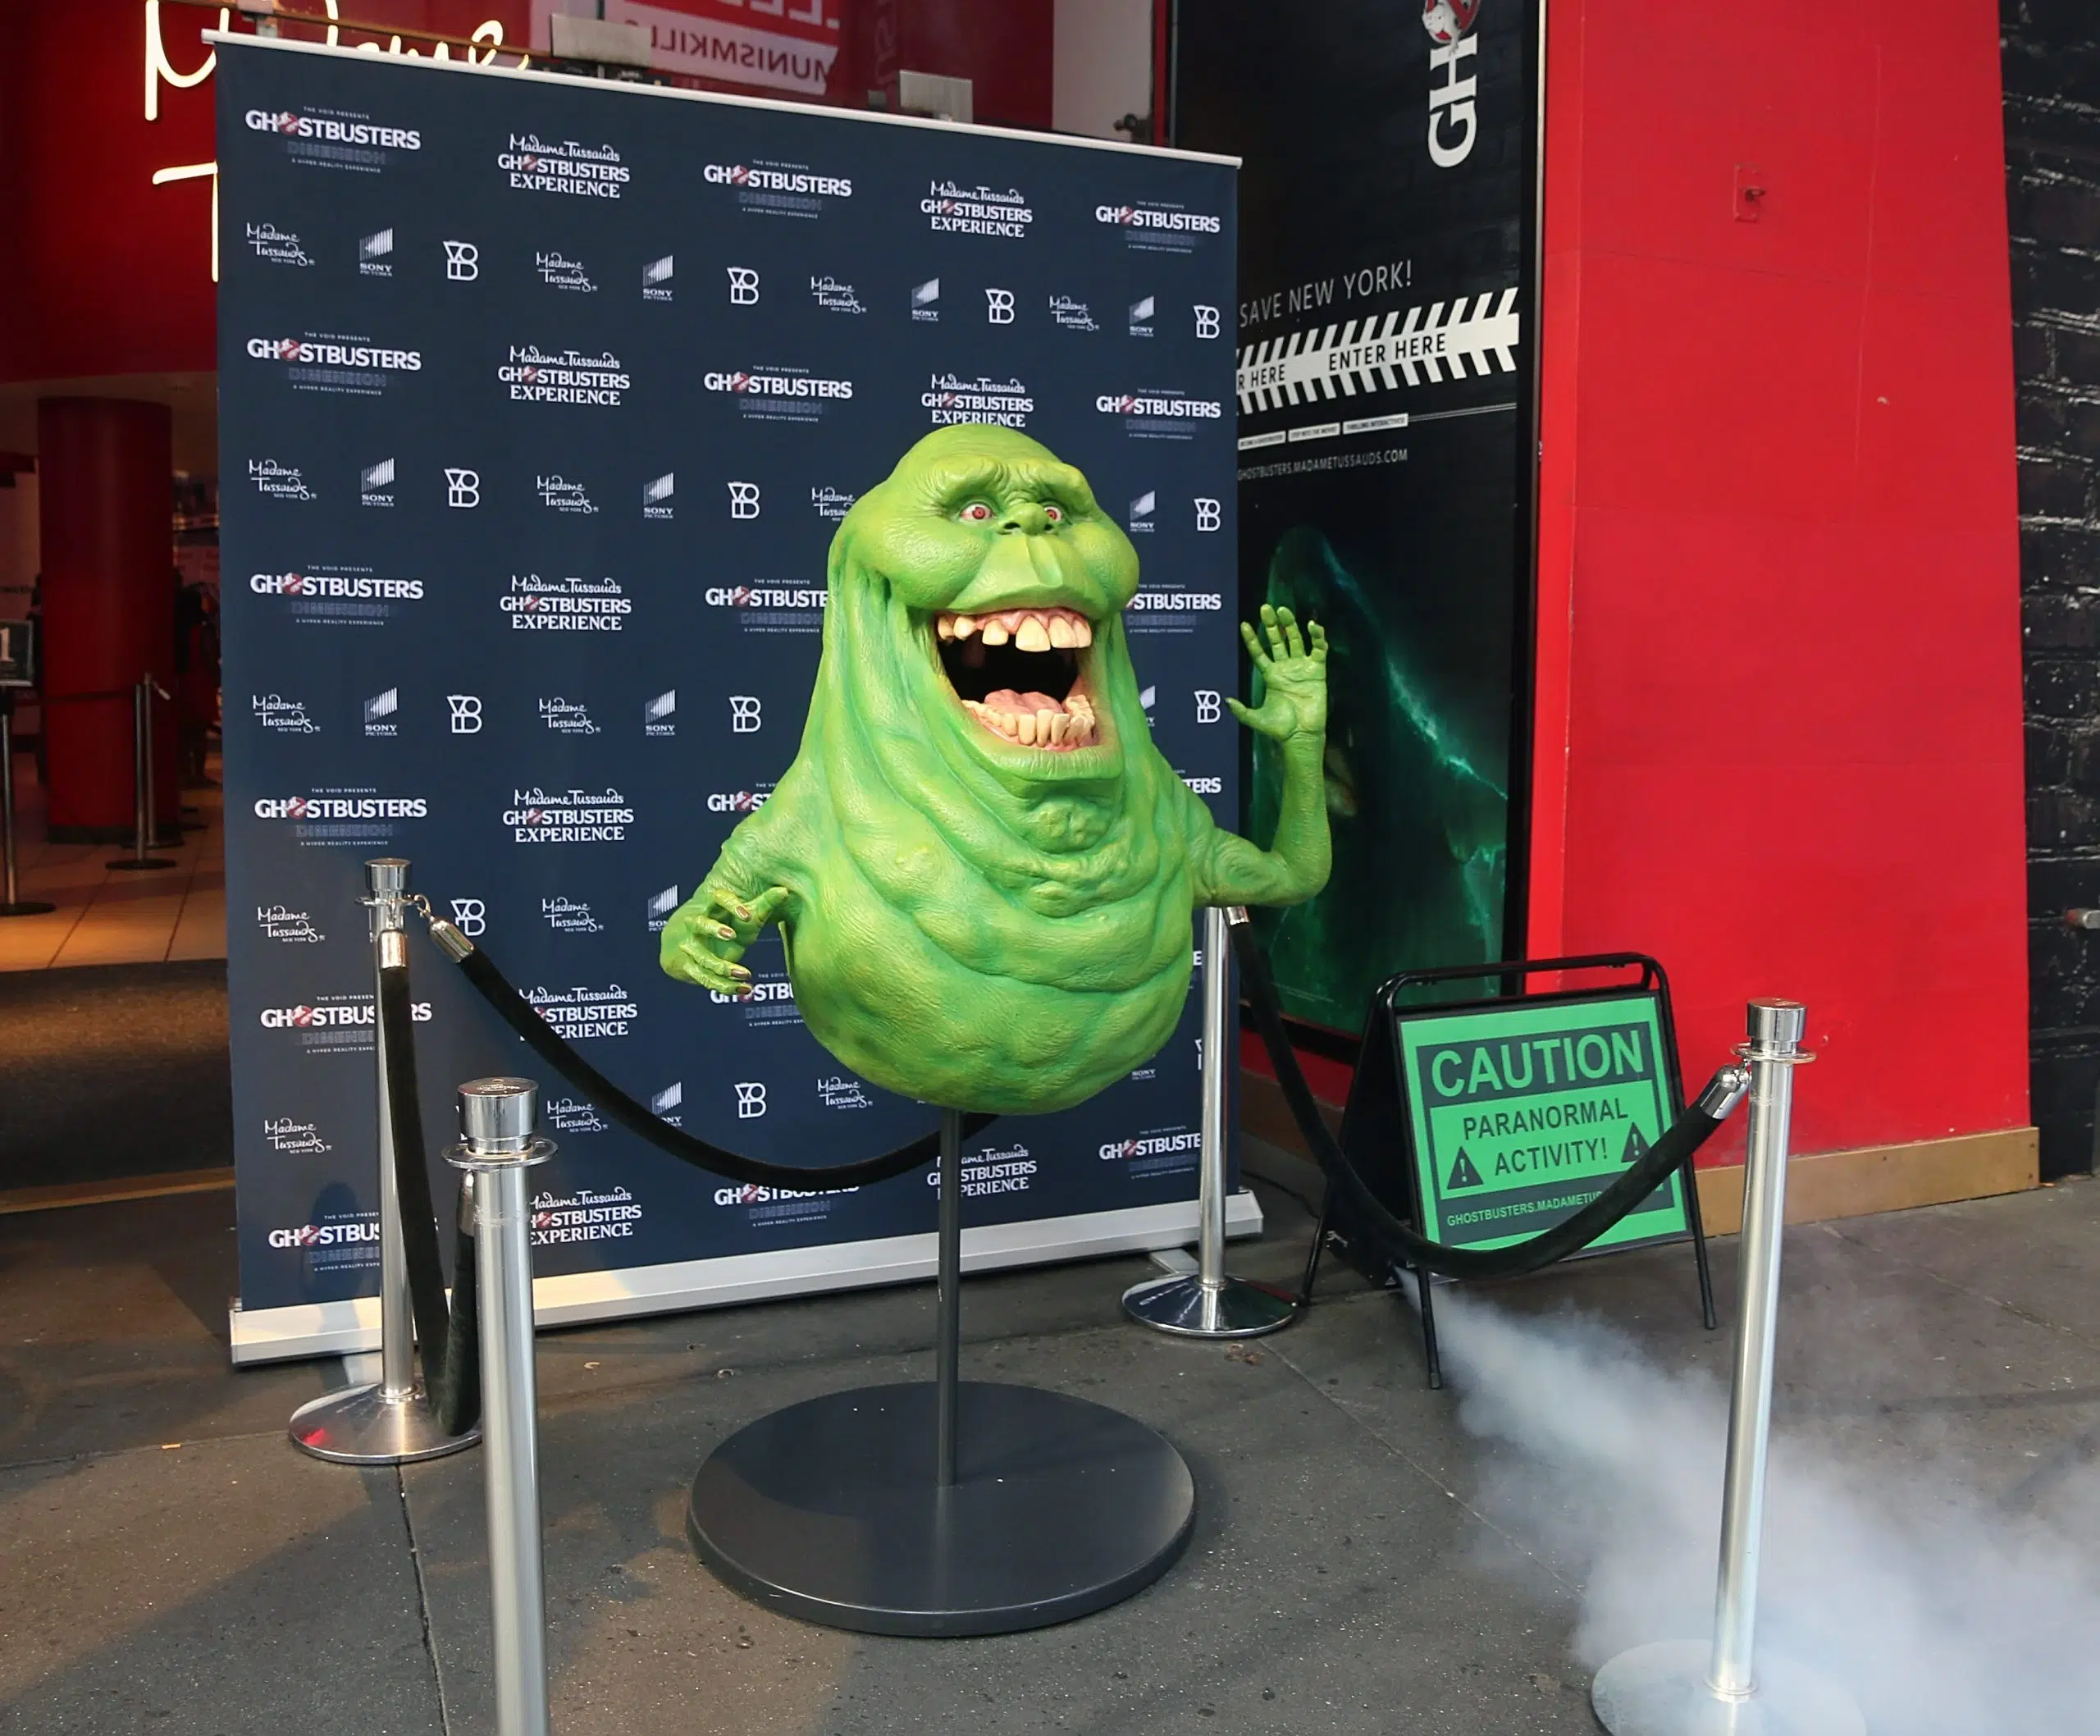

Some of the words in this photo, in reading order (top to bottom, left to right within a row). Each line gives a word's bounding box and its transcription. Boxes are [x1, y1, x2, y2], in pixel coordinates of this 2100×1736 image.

[246, 110, 421, 150] GHOSTBUSTERS
[509, 133, 564, 156] Madame
[564, 140, 619, 162] Tussauds
[499, 153, 630, 183] GHOSTBUSTERS
[510, 172, 620, 199] EXPERIENCE
[704, 164, 851, 198] GHOSTBUSTERS
[931, 180, 979, 201] Madame
[977, 185, 1024, 204] Tussauds
[921, 199, 1033, 223] GHOSTBUSTERS
[1095, 206, 1220, 233] GHOSTBUSTERS
[931, 216, 1025, 238] EXPERIENCE
[360, 263, 392, 272] SONY
[643, 288, 673, 297] SONY
[1239, 292, 1282, 327] SAVE
[1289, 278, 1334, 314] NEW
[1343, 259, 1412, 300] YORK!
[912, 309, 938, 318] SONY
[247, 338, 421, 371] GHOSTBUSTERS
[509, 345, 564, 366] Madame
[564, 350, 620, 369] Tussauds
[1250, 364, 1285, 388] HERE
[1329, 345, 1386, 372] ENTER
[1395, 332, 1446, 359] HERE
[499, 365, 630, 390] GHOSTBUSTERS
[704, 371, 852, 400] GHOSTBUSTERS
[932, 374, 980, 392] Madame
[977, 377, 1025, 394] Tussauds
[510, 385, 621, 406] EXPERIENCE
[921, 392, 1034, 413] GHOSTBUSTERS
[1096, 395, 1221, 419] GHOSTBUSTERS
[932, 410, 1025, 428] EXPERIENCE
[362, 494, 394, 503] SONY
[250, 573, 424, 600] GHOSTBUSTERS
[511, 574, 567, 593] Madame
[566, 578, 622, 595] Tussauds
[705, 585, 828, 608] GHOSTBUSTE
[500, 596, 632, 614] GHOSTBUSTERS
[512, 614, 622, 631] EXPERIENCE
[254, 796, 427, 820] GHOSTBUSTERS
[514, 788, 569, 806] Madame
[568, 788, 624, 805] Tussauds
[504, 807, 634, 826] GHOSTBUSTERS
[515, 826, 624, 843] EXPERIENCE
[572, 985, 628, 1001] Tussauds
[550, 1022, 628, 1039] ERIENCE
[1431, 1030, 1643, 1097] CAUTION
[1463, 1098, 1628, 1140] PARANORMAL
[982, 1144, 1029, 1163] Tussauds
[1099, 1132, 1201, 1160] GHOSTBUSTE
[1495, 1137, 1608, 1176] ACTIVITY!
[577, 1186, 632, 1204] Tussauds
